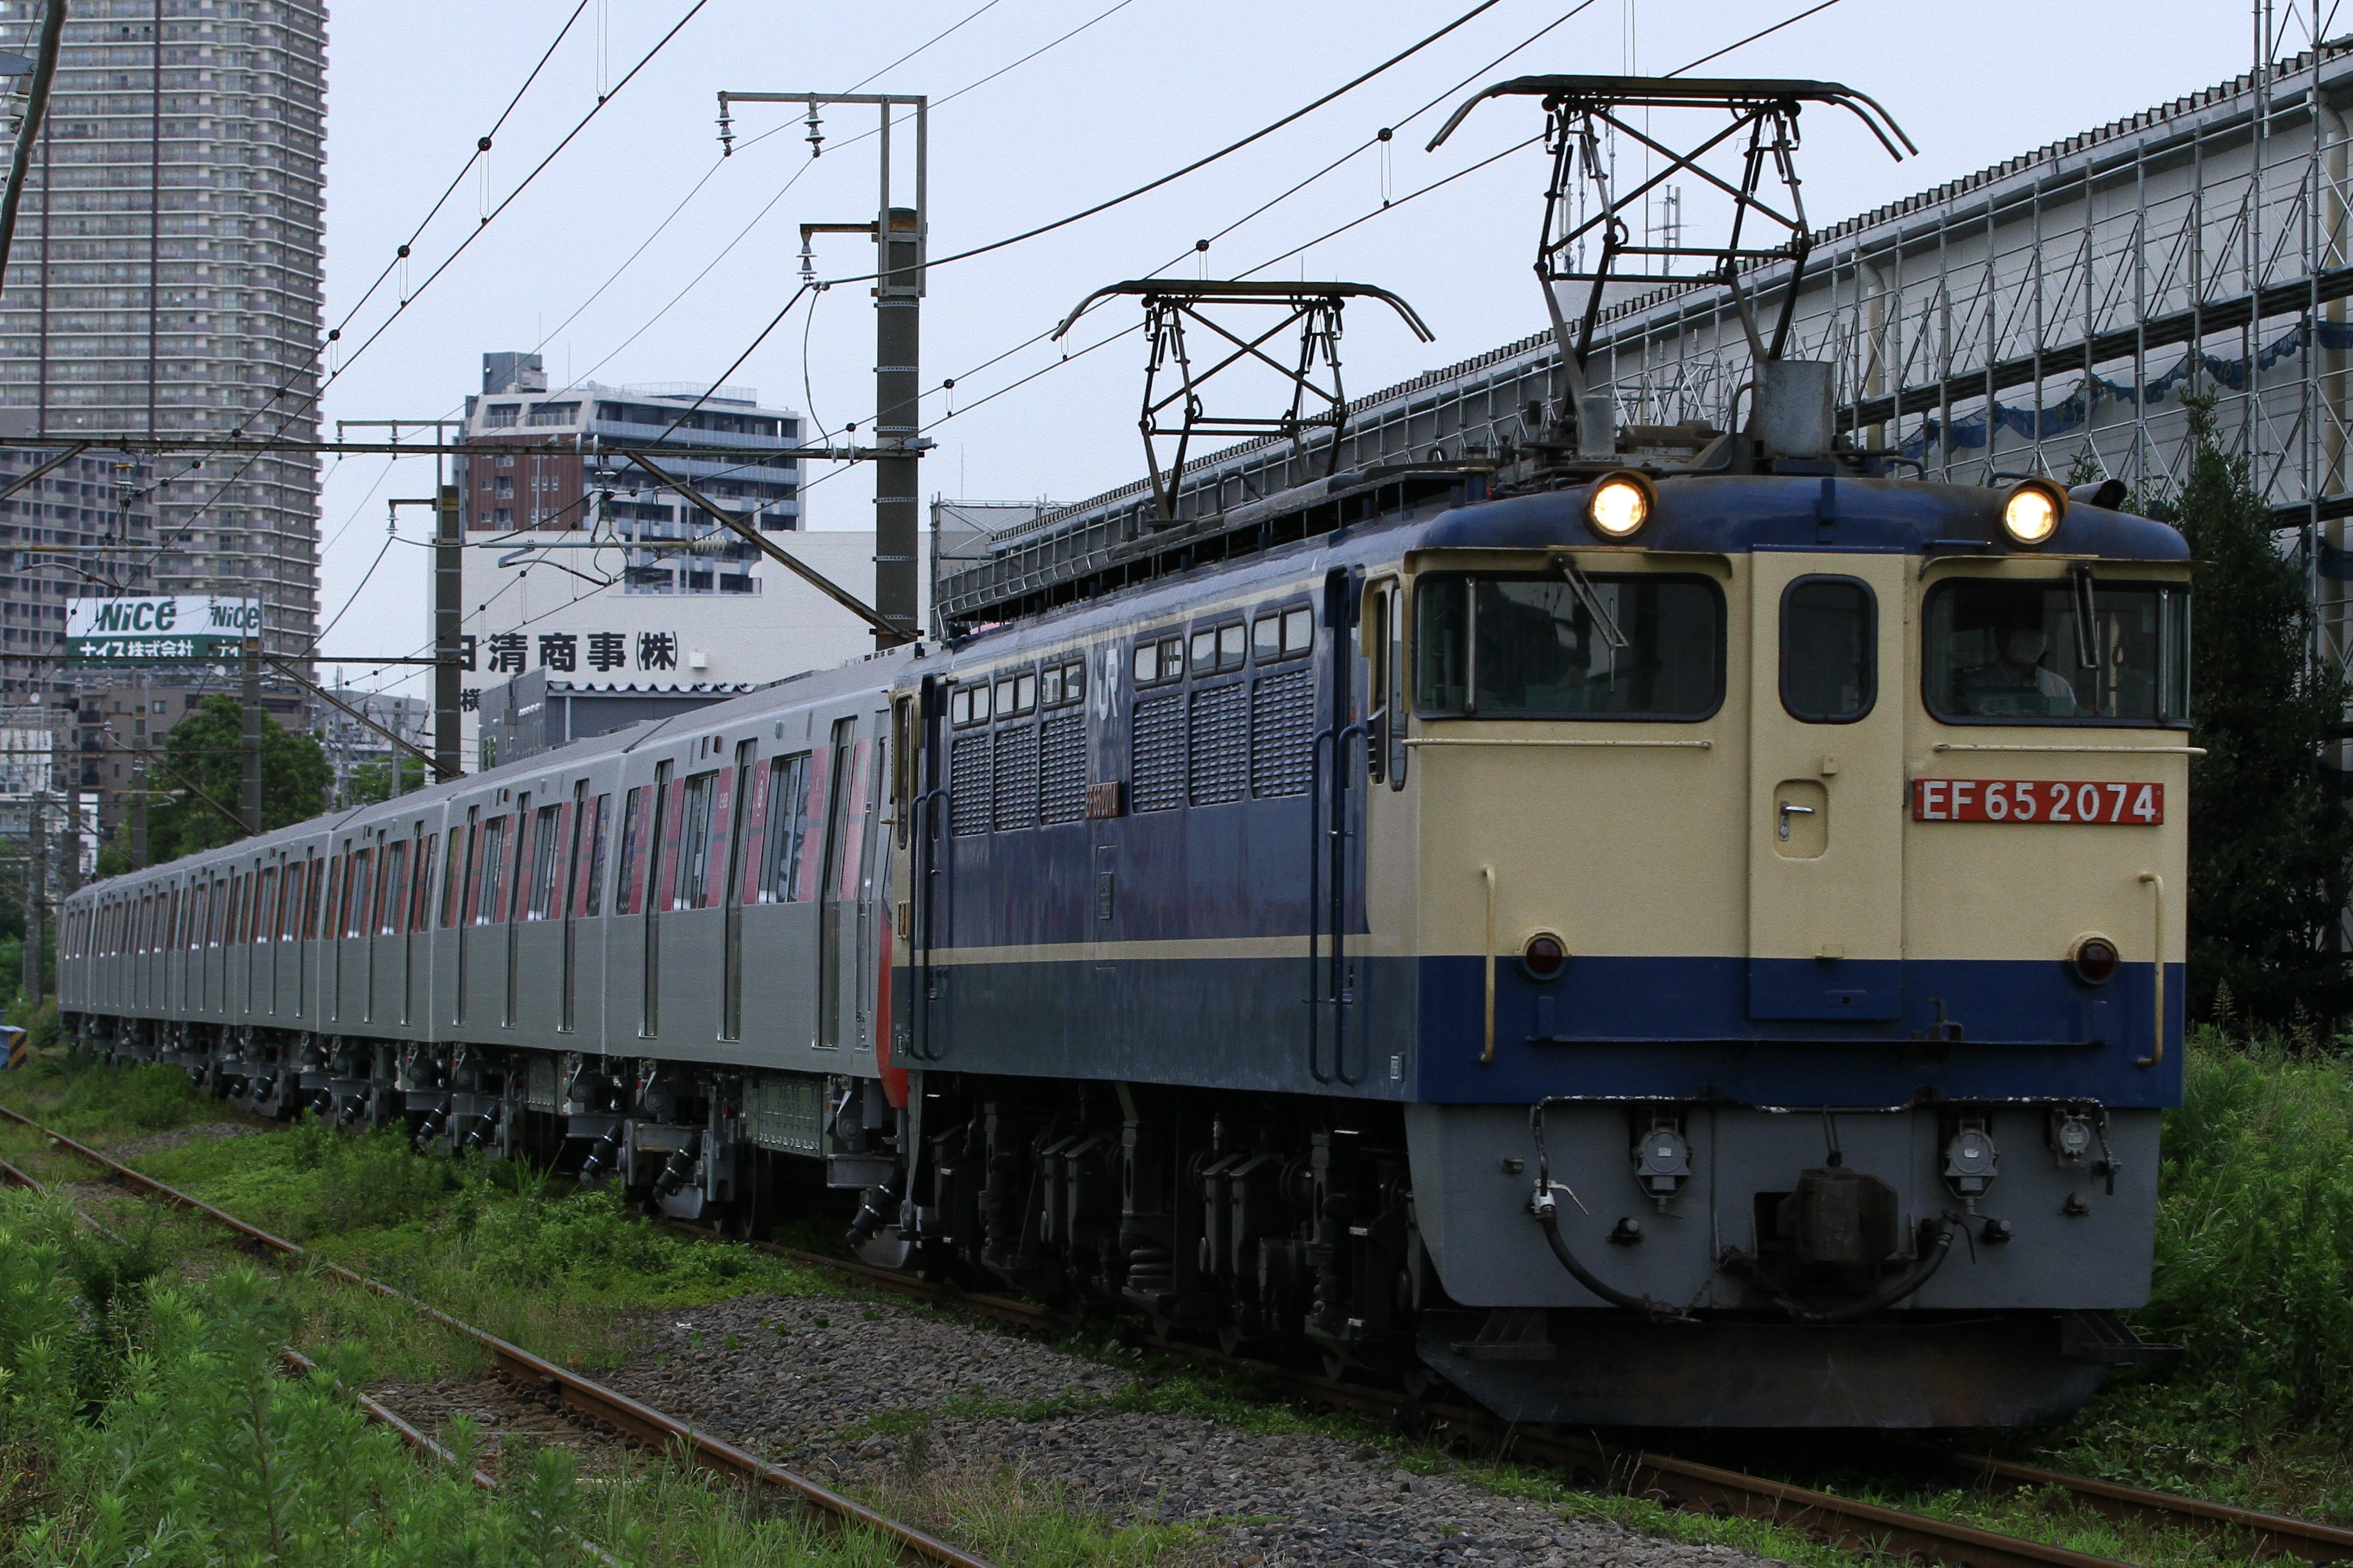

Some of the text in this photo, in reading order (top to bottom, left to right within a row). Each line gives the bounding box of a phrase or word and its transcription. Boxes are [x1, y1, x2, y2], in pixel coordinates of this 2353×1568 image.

[79, 639, 194, 658] ナイス株式会社
[1098, 648, 1118, 720] JR
[2049, 783, 2156, 822] 2074
